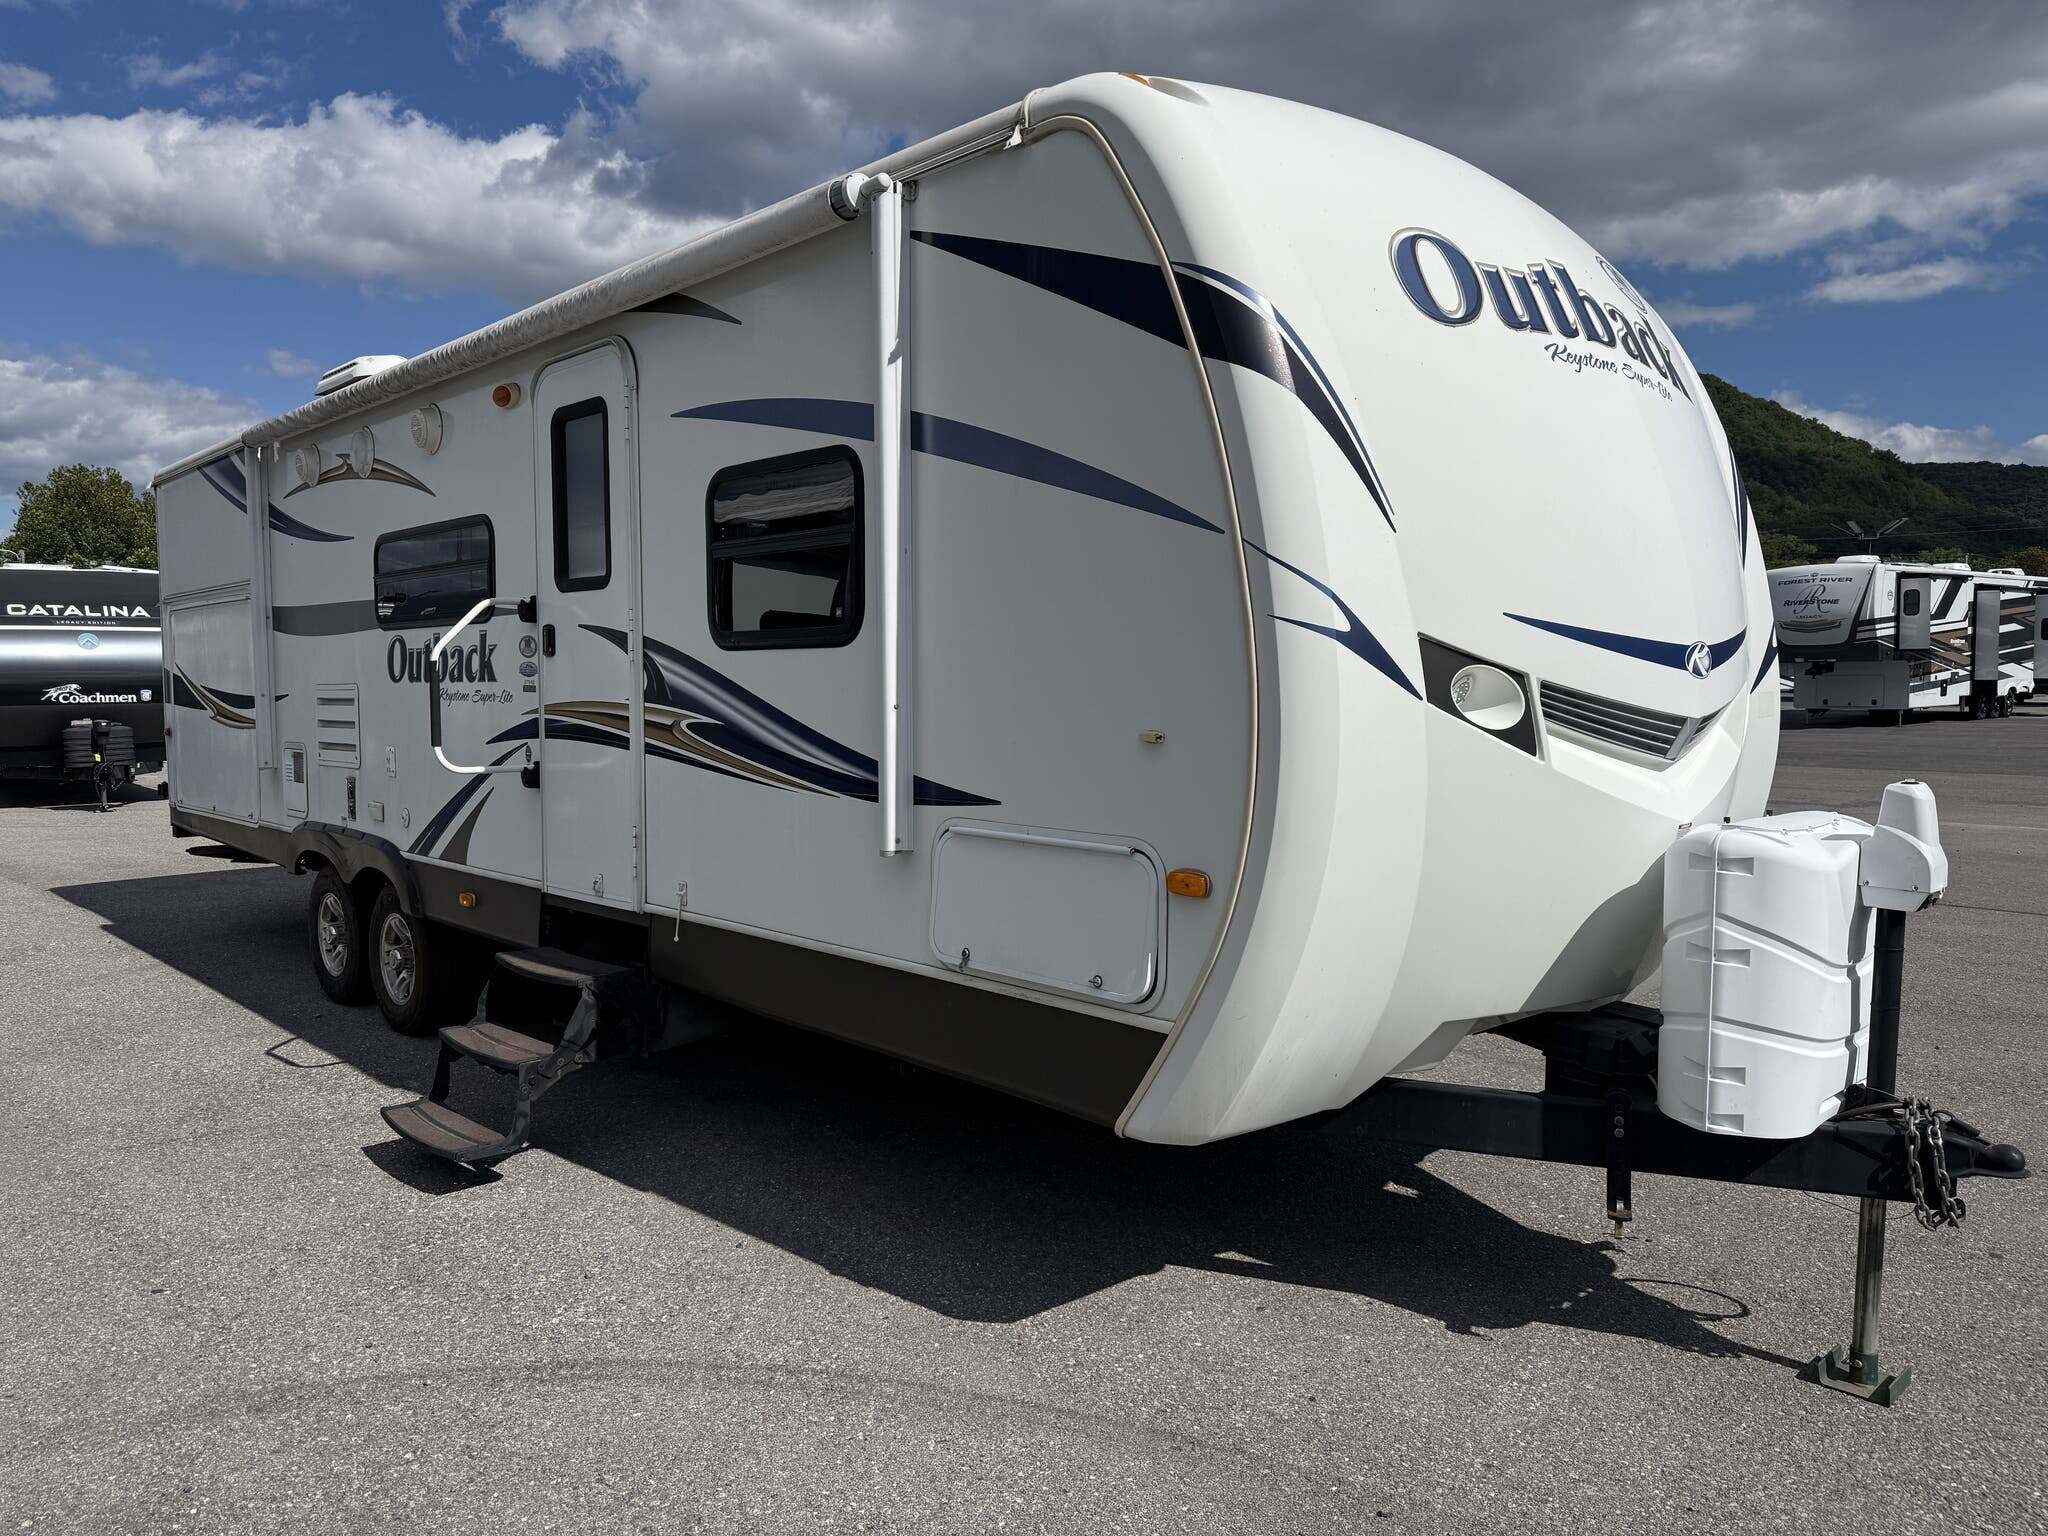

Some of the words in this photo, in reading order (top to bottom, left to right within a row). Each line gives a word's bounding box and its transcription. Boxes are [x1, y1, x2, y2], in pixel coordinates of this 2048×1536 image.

[1388, 226, 1696, 406] Outback
[1544, 342, 1618, 374] Keystone
[1778, 577, 1818, 586] FOREST
[6, 604, 151, 618] CATALINA
[59, 692, 137, 703] Coachmen
[440, 688, 470, 707] Keystone
[472, 689, 514, 706] Super-Lite
